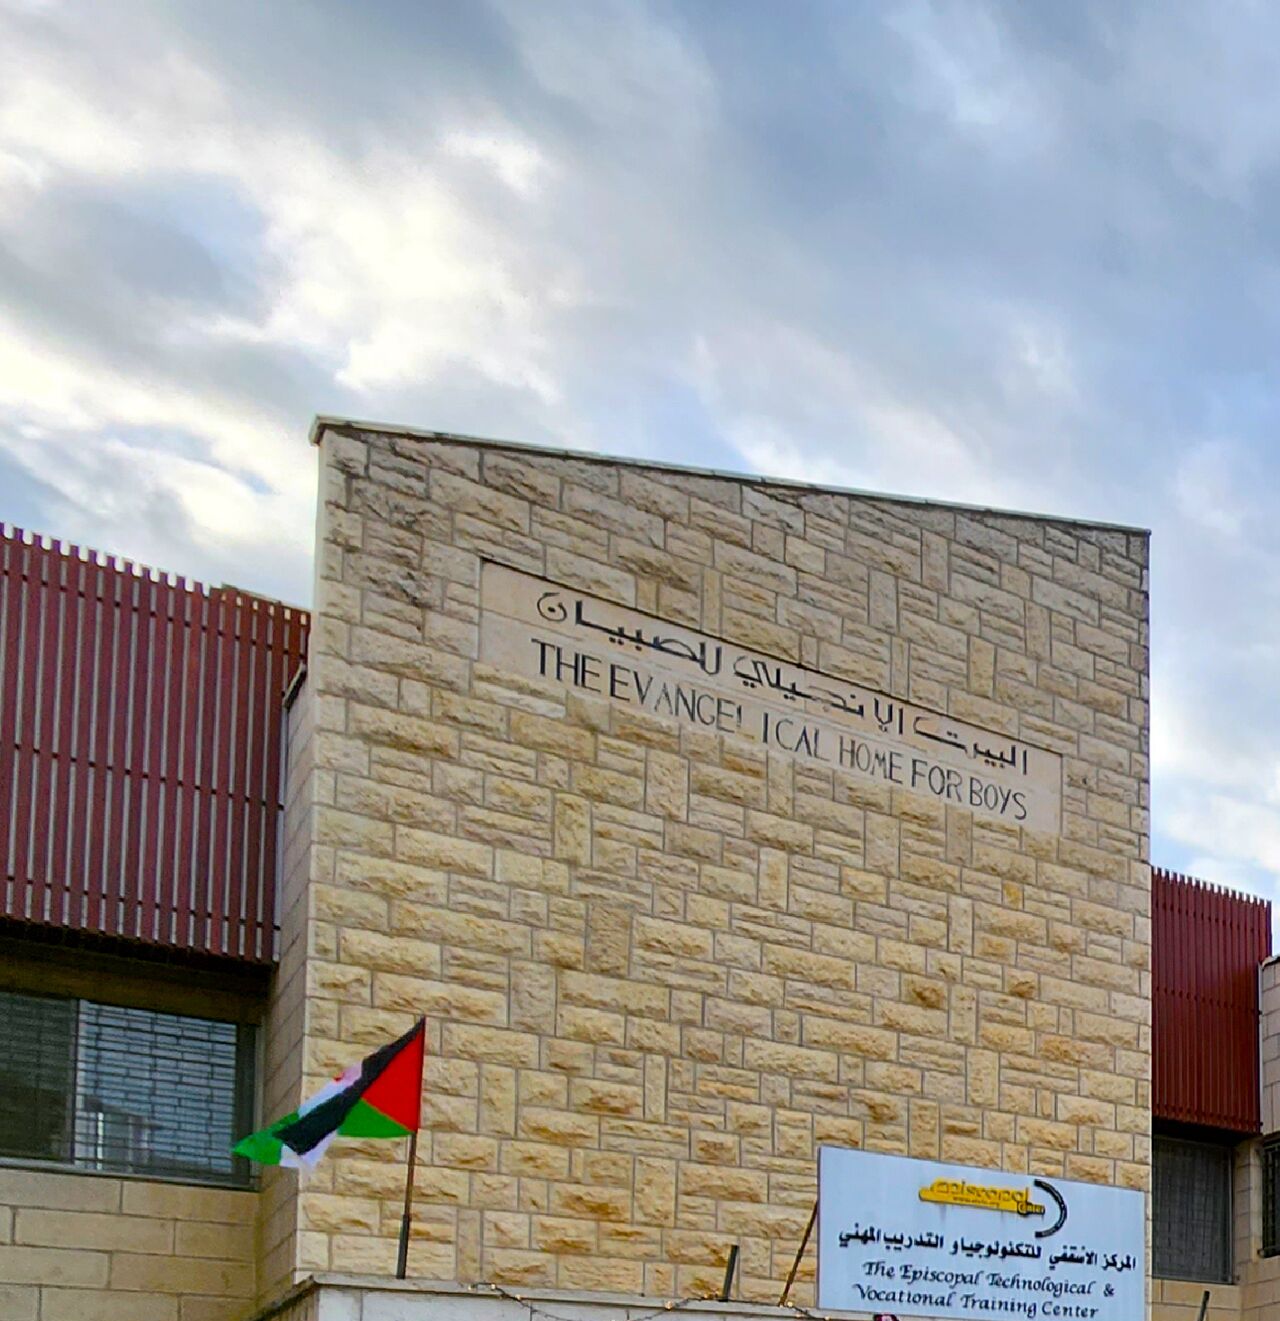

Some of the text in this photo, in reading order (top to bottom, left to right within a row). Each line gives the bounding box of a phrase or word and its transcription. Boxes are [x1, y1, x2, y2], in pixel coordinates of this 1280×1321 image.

[530, 636, 602, 694] THE
[837, 734, 903, 785] HOME
[910, 758, 963, 803] FOR
[968, 775, 1028, 822] BOYS
[838, 1222, 882, 1248] المهني
[883, 1231, 944, 1251] التدريب
[1101, 1252, 1137, 1272] المركز
[862, 1260, 1115, 1298] The Episcopal Technological &
[852, 1283, 1099, 1319] Vocational Training Center
